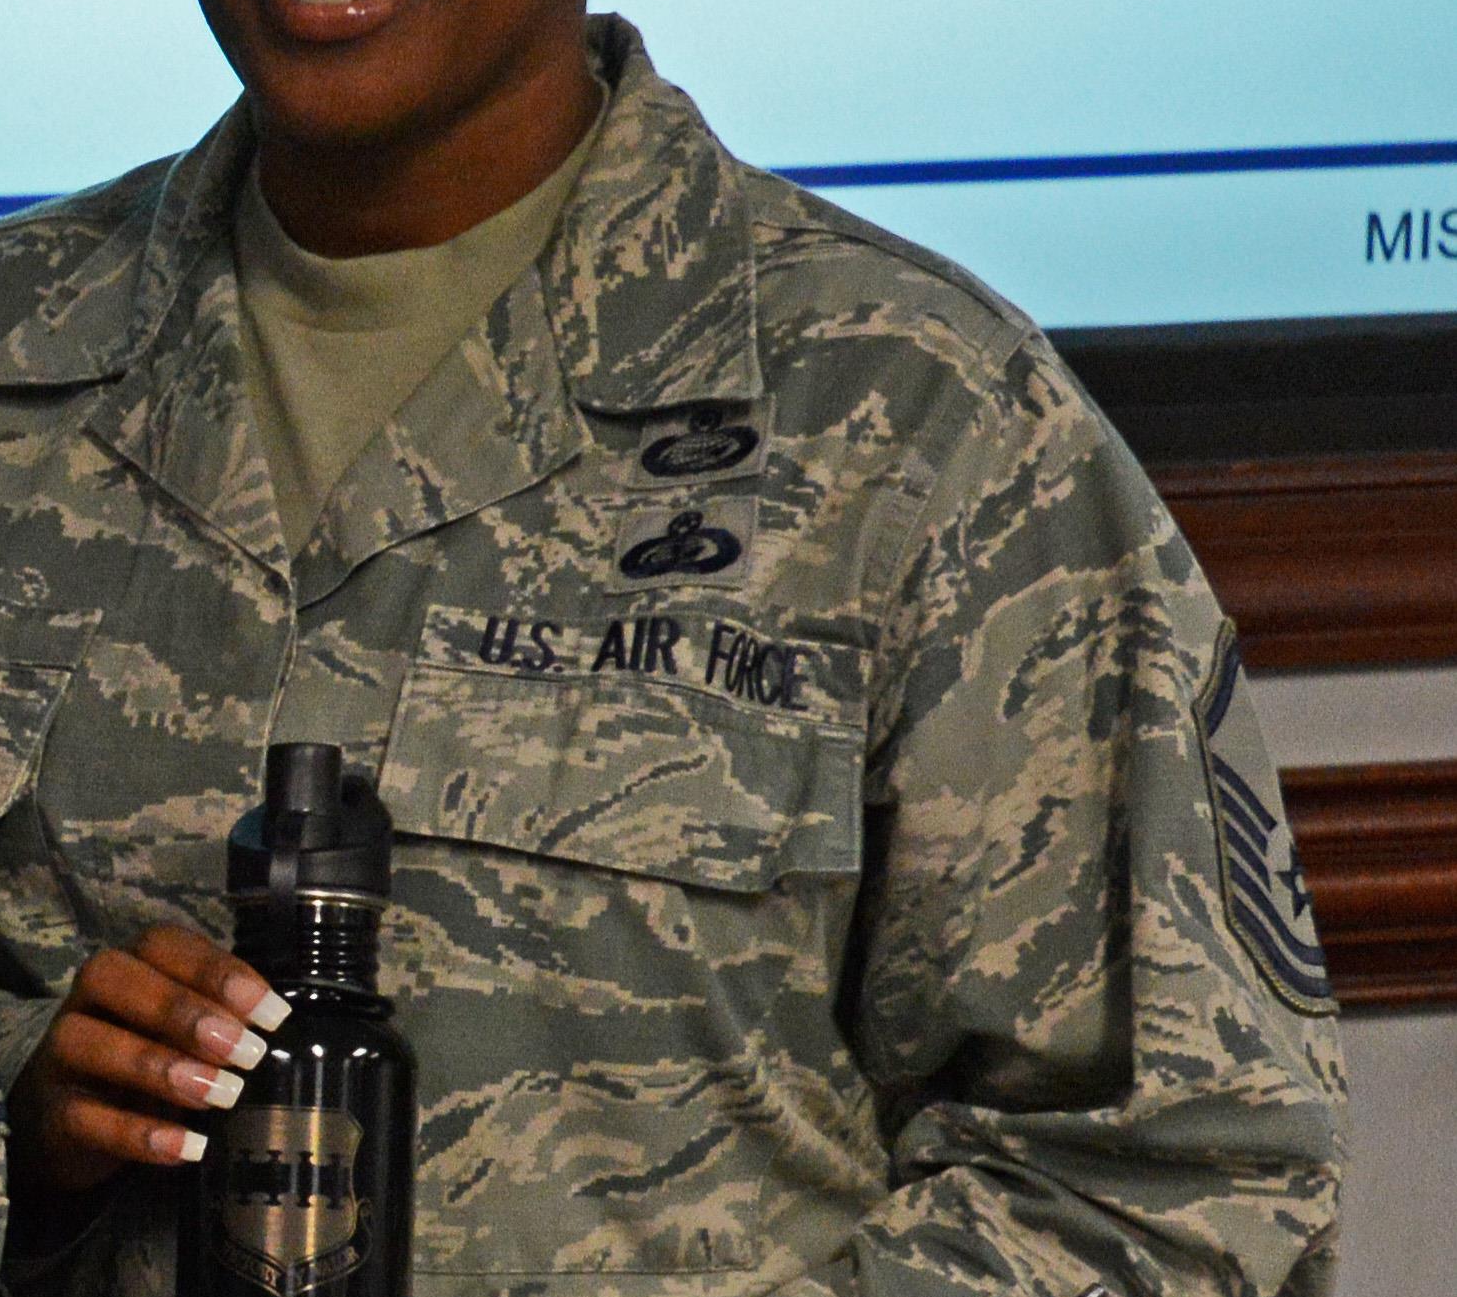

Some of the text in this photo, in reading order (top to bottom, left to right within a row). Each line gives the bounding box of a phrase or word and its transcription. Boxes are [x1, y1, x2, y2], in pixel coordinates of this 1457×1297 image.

[478, 614, 811, 712] U.S. AIR FORCE
